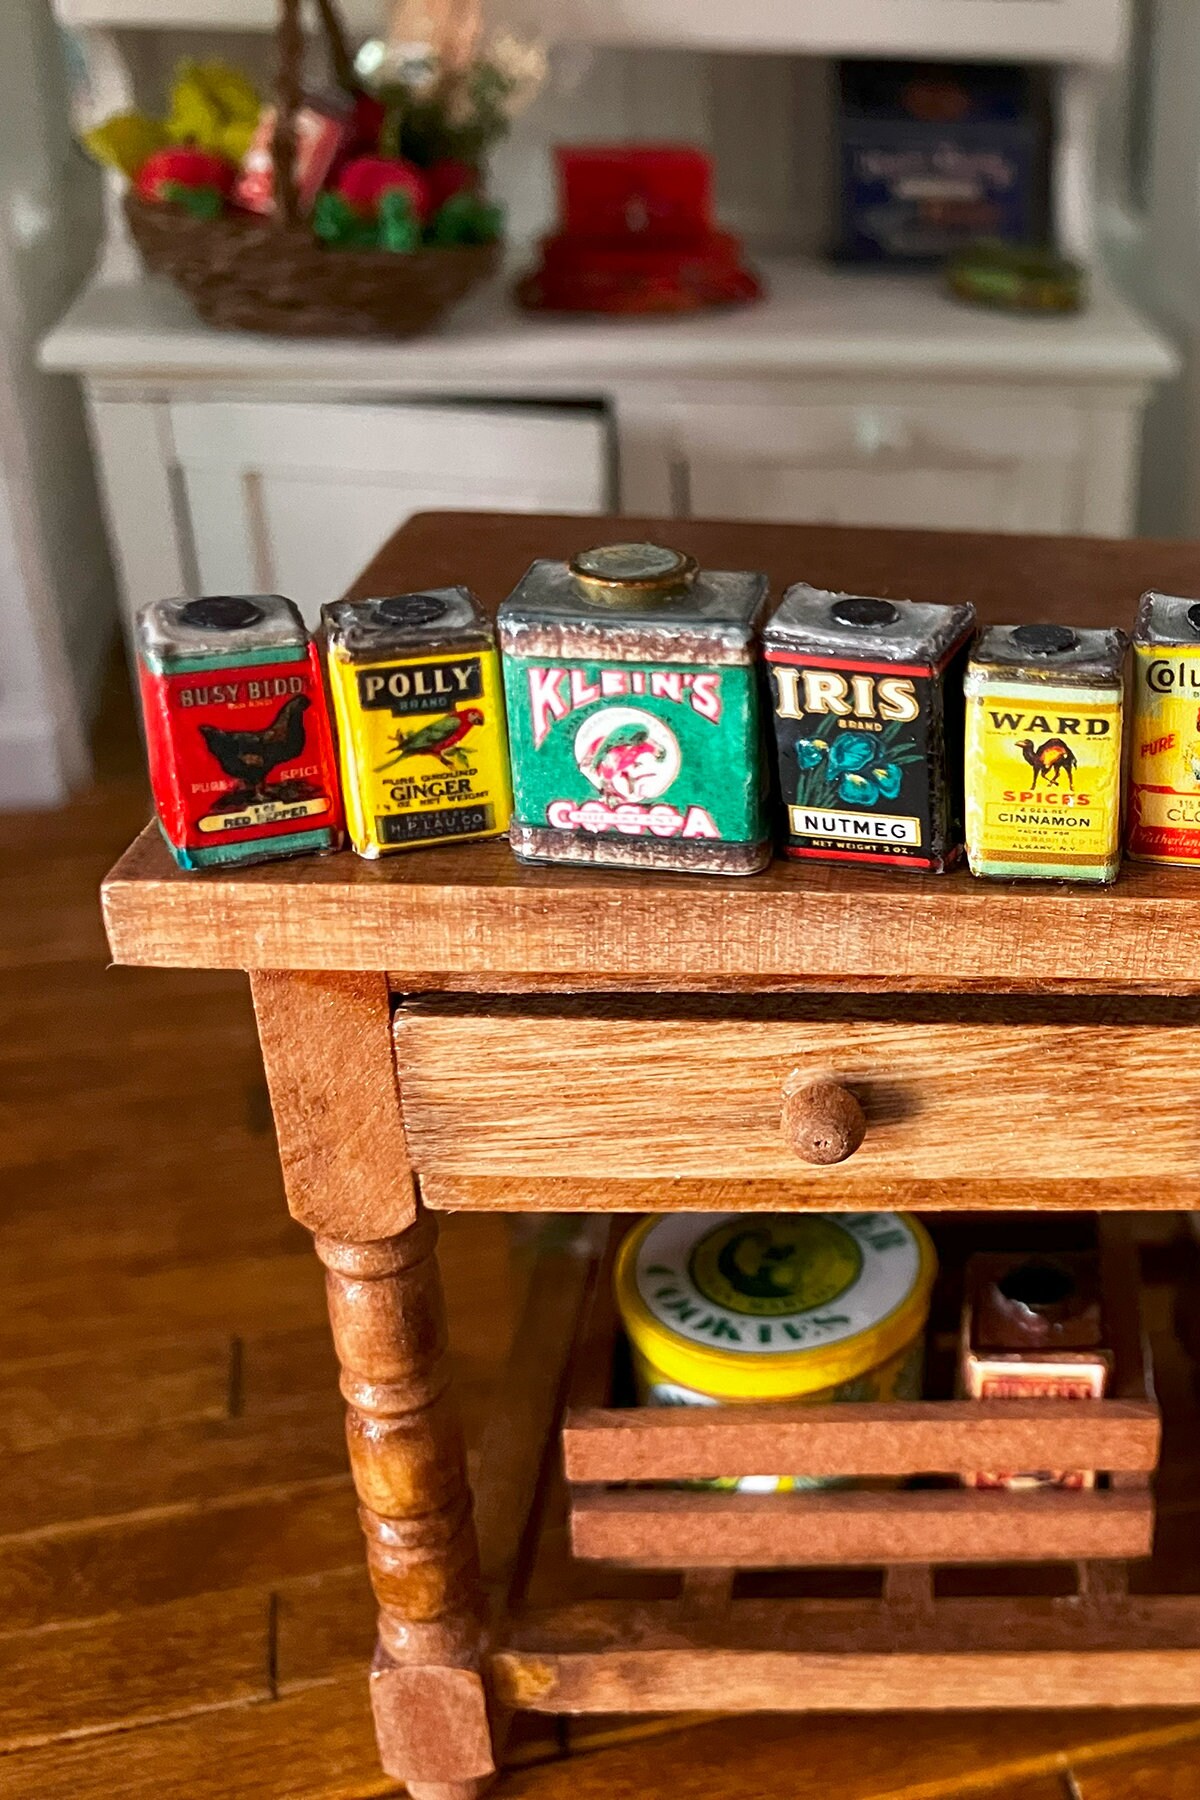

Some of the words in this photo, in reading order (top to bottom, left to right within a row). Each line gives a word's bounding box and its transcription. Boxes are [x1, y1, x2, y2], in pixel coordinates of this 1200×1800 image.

[365, 666, 472, 701] POLLY
[773, 667, 920, 722] IRIS
[181, 685, 239, 707] BUSY
[400, 697, 448, 711] BRAND
[529, 667, 722, 751] KLEIN'S
[838, 719, 883, 732] BRAND
[988, 711, 1110, 736] WARD
[1140, 733, 1176, 757] PURE
[390, 779, 472, 802] GINGER
[1003, 790, 1091, 806] SPICES
[224, 816, 251, 829] RED
[804, 816, 906, 838] NUTMEG
[998, 813, 1090, 827] CINNAMON
[812, 840, 833, 848] NET
[836, 842, 877, 852] WEIGHT
